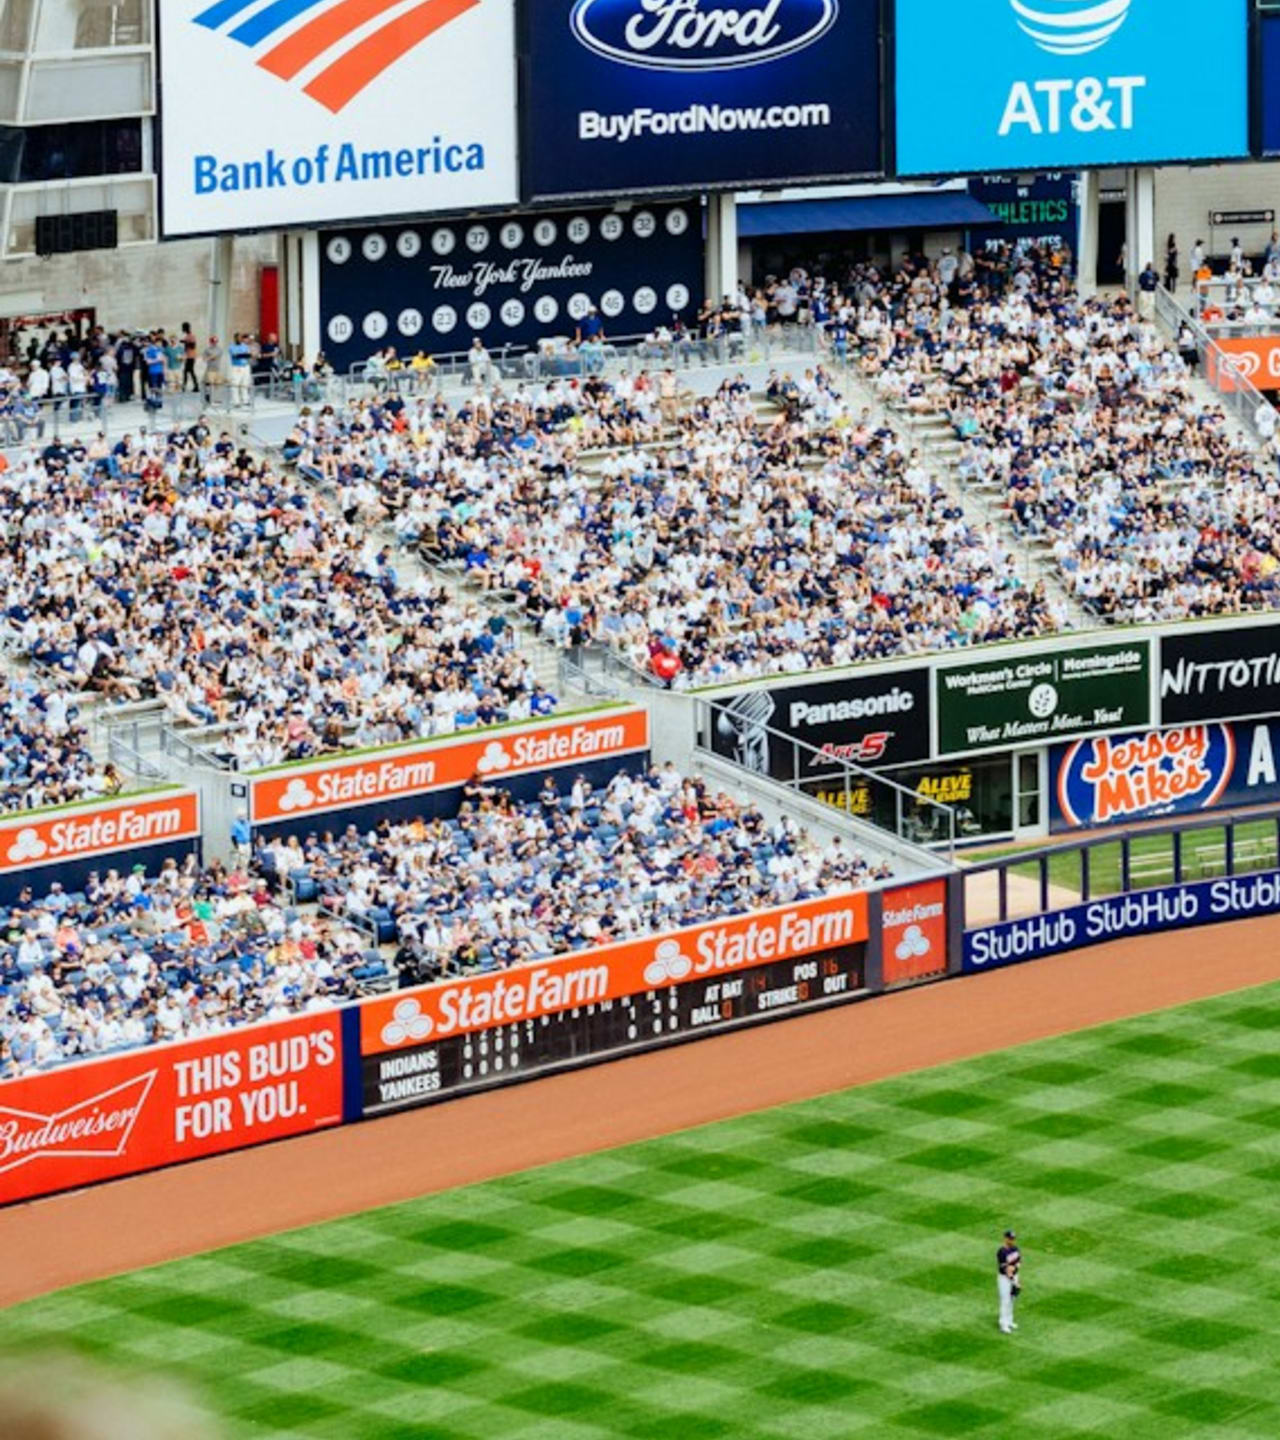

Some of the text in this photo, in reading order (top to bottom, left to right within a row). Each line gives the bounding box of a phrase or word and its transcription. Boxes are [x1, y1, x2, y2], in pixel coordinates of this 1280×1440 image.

[578, 103, 831, 140] BuyFordNow.com
[997, 75, 1146, 137] AT&T
[194, 136, 485, 195] Bank of America
[429, 255, 593, 296] New York Yankees
[1016, 662, 1052, 679] Circle
[1064, 650, 1141, 671] Morningside
[790, 687, 914, 728] Panasonic
[1082, 724, 1209, 781] Jersey
[1247, 725, 1278, 787] A
[1094, 755, 1209, 822] Mike's
[971, 911, 1076, 964] StubHub
[1086, 889, 1199, 938] StubHub
[758, 974, 847, 1009] STRIKE OUT
[691, 1004, 720, 1025] BALL
[173, 1030, 335, 1097] THIS BUD'S
[380, 1050, 438, 1080] INDIANS
[379, 1072, 440, 1101] YANKEES
[175, 1082, 307, 1142] FOR YOU.
